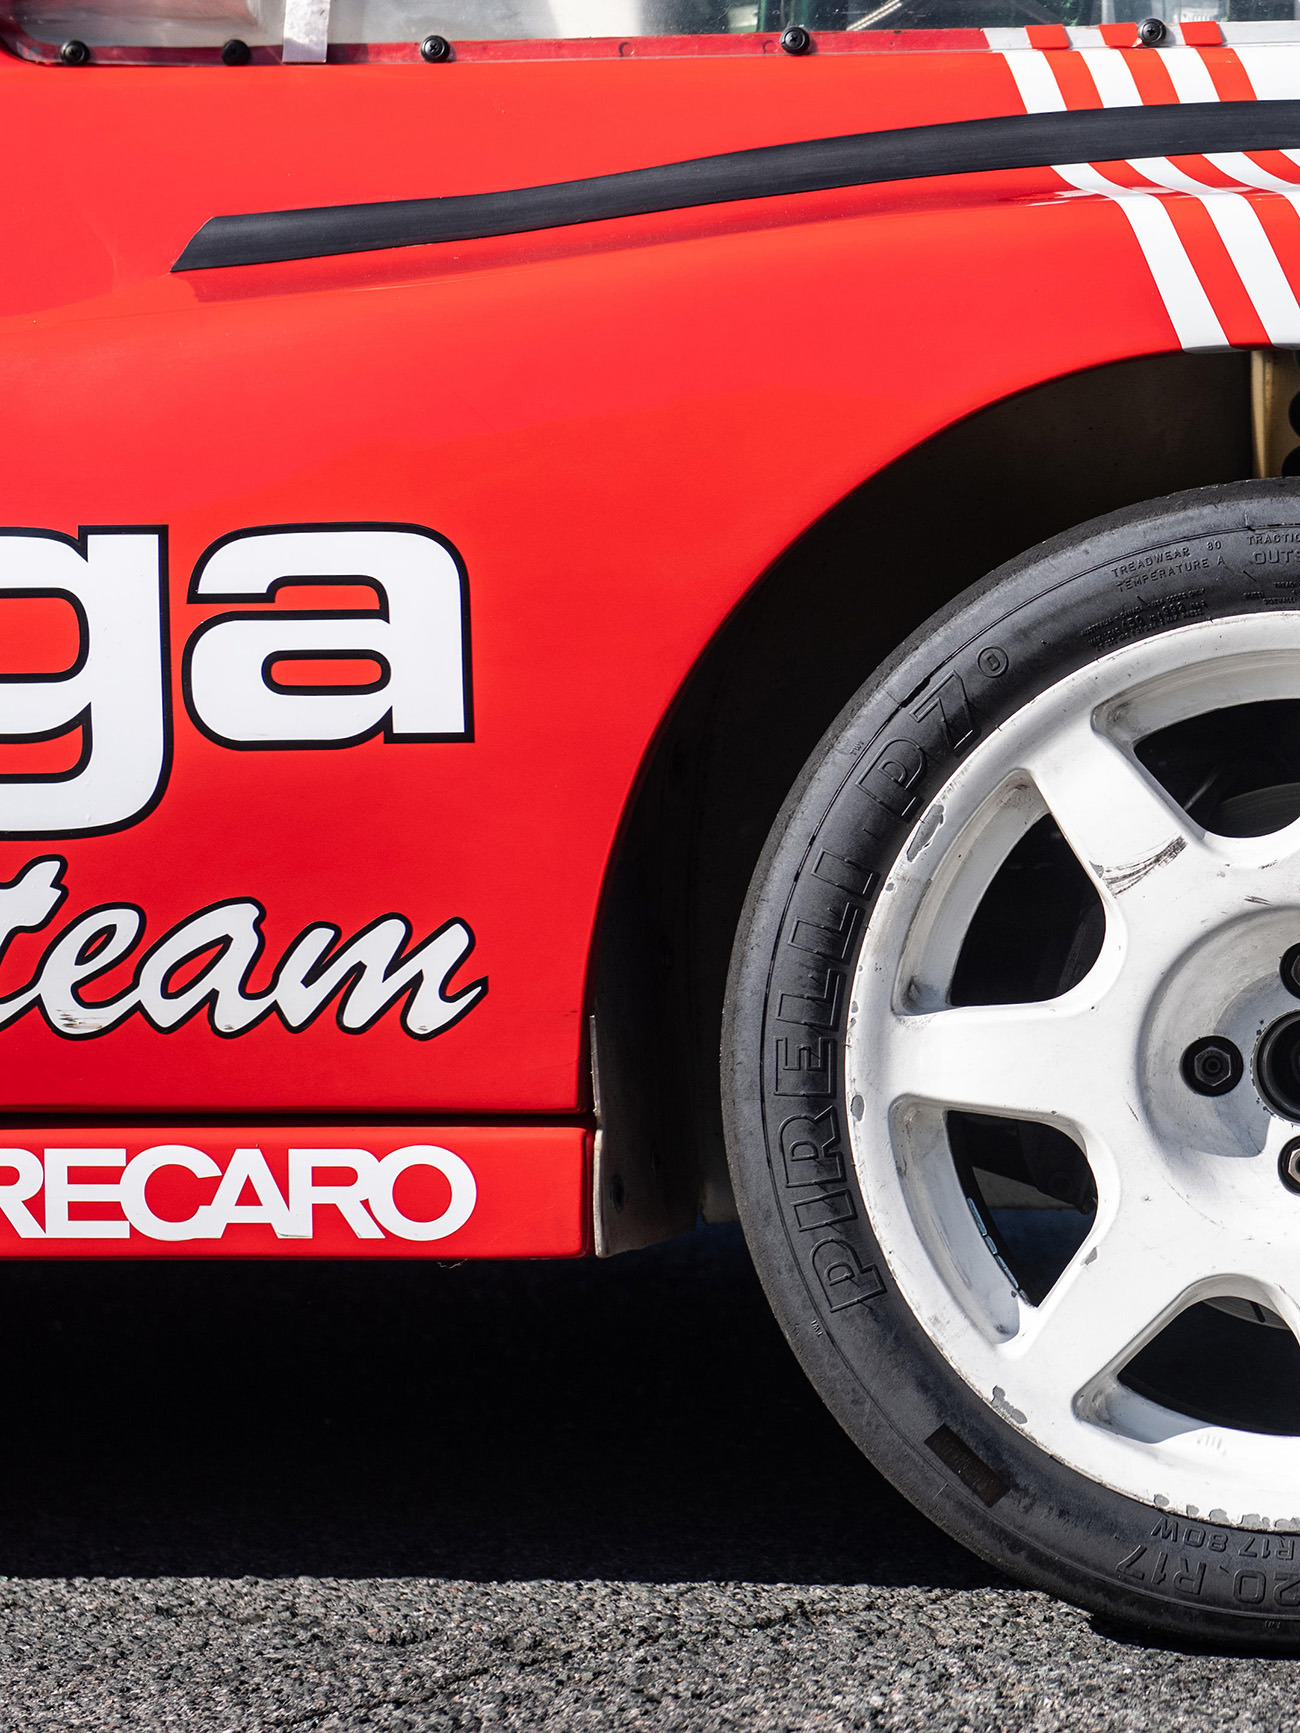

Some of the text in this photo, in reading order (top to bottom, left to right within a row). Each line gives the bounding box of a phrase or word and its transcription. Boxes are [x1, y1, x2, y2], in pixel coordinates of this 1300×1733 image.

[1112, 547, 1190, 578] TREADWEAR
[1116, 554, 1225, 592] TEMPERATURE A
[0, 855, 489, 1041] team
[774, 671, 985, 1315] PIRELLI P7
[1149, 1514, 1229, 1554] 80W
[1238, 1535, 1294, 1560] R17
[1113, 1539, 1207, 1596] R17
